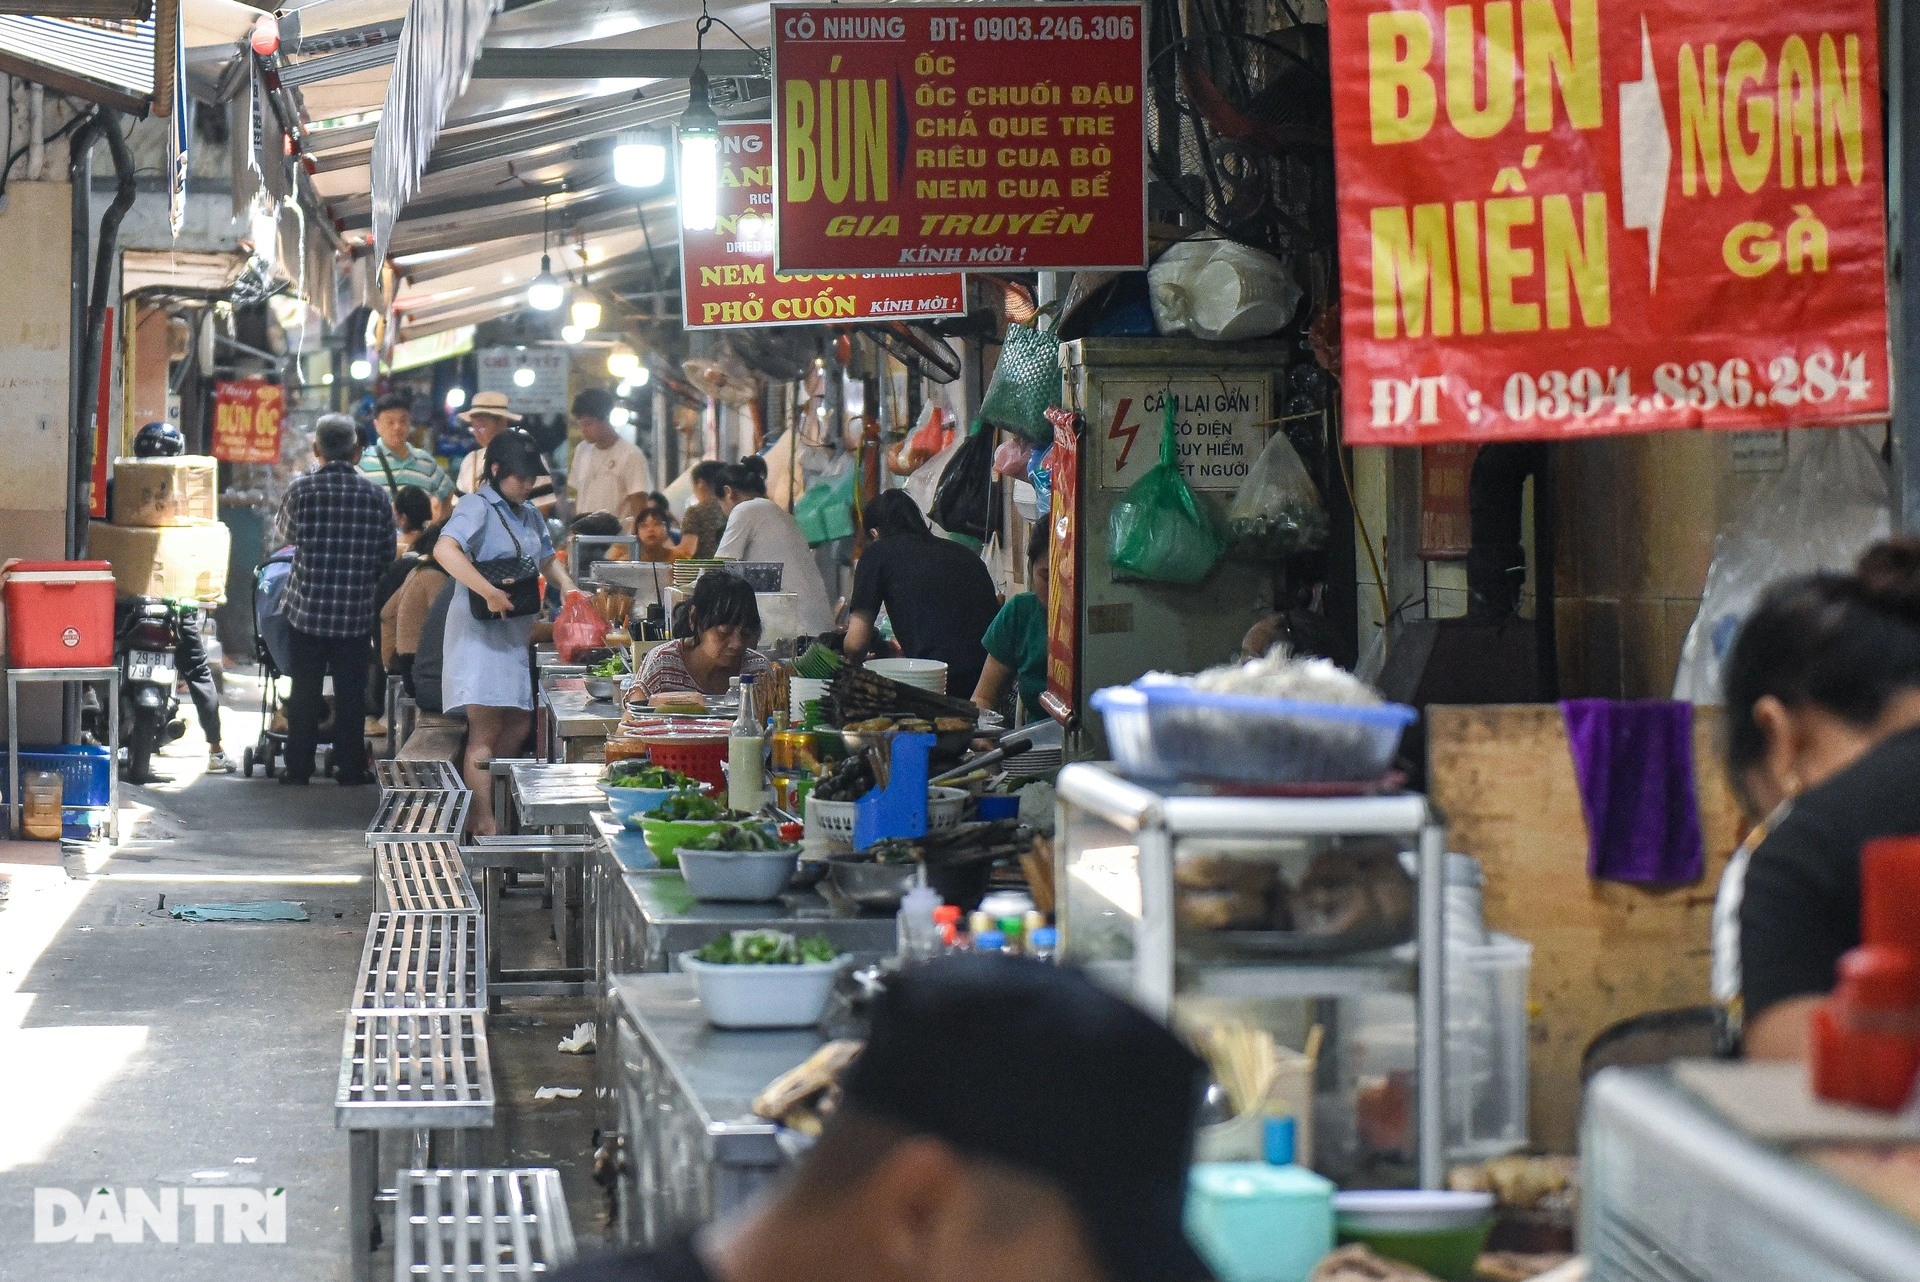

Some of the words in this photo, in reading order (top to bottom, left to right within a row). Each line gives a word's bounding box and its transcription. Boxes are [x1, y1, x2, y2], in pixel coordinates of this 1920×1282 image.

[785, 12, 816, 39] CÔ
[823, 16, 906, 39] NHUNG
[930, 17, 966, 42] ĐT:
[974, 16, 1134, 41] 0903.246.306
[914, 50, 956, 76] ỐC
[915, 80, 956, 107] ỐC
[967, 80, 1061, 106] CHUỐI
[1071, 82, 1134, 109] ĐẬU
[785, 55, 889, 204] BÚN
[916, 110, 979, 137] CHẢ
[988, 116, 1048, 139] QUE
[1058, 116, 1115, 136] TRE
[1678, 33, 1863, 197] NGAN
[717, 134, 763, 154] NG
[916, 145, 987, 168] RIÊU
[997, 148, 1060, 167] CUA
[1070, 143, 1112, 167] BÒ
[916, 178, 987, 199] NEM
[998, 178, 1061, 198] CUA
[1071, 170, 1112, 197] BỂ
[825, 215, 900, 237] GIA
[919, 206, 1094, 236] TRUYỀN
[899, 244, 963, 263] KÍNH
[967, 243, 1014, 262] MỜI
[1020, 247, 1027, 262] !
[1370, 145, 1611, 340] MIẾN
[1722, 205, 1829, 279] GÀ
[700, 263, 766, 286] NEM
[702, 293, 764, 323] PHỞ
[771, 286, 857, 320] CUỐN
[869, 297, 913, 313] KÍNH
[917, 295, 949, 311] MỜI
[1185, 394, 1209, 416] LẠI
[1215, 387, 1249, 412] GẦN
[1370, 376, 1447, 428] ĐT
[1502, 350, 1872, 422] 0394.836.284
[1197, 419, 1232, 438] ĐIỆN
[1206, 437, 1244, 456] HIỂM
[1200, 461, 1249, 477] NGƯỜI
[136, 652, 167, 666] 29-B1
